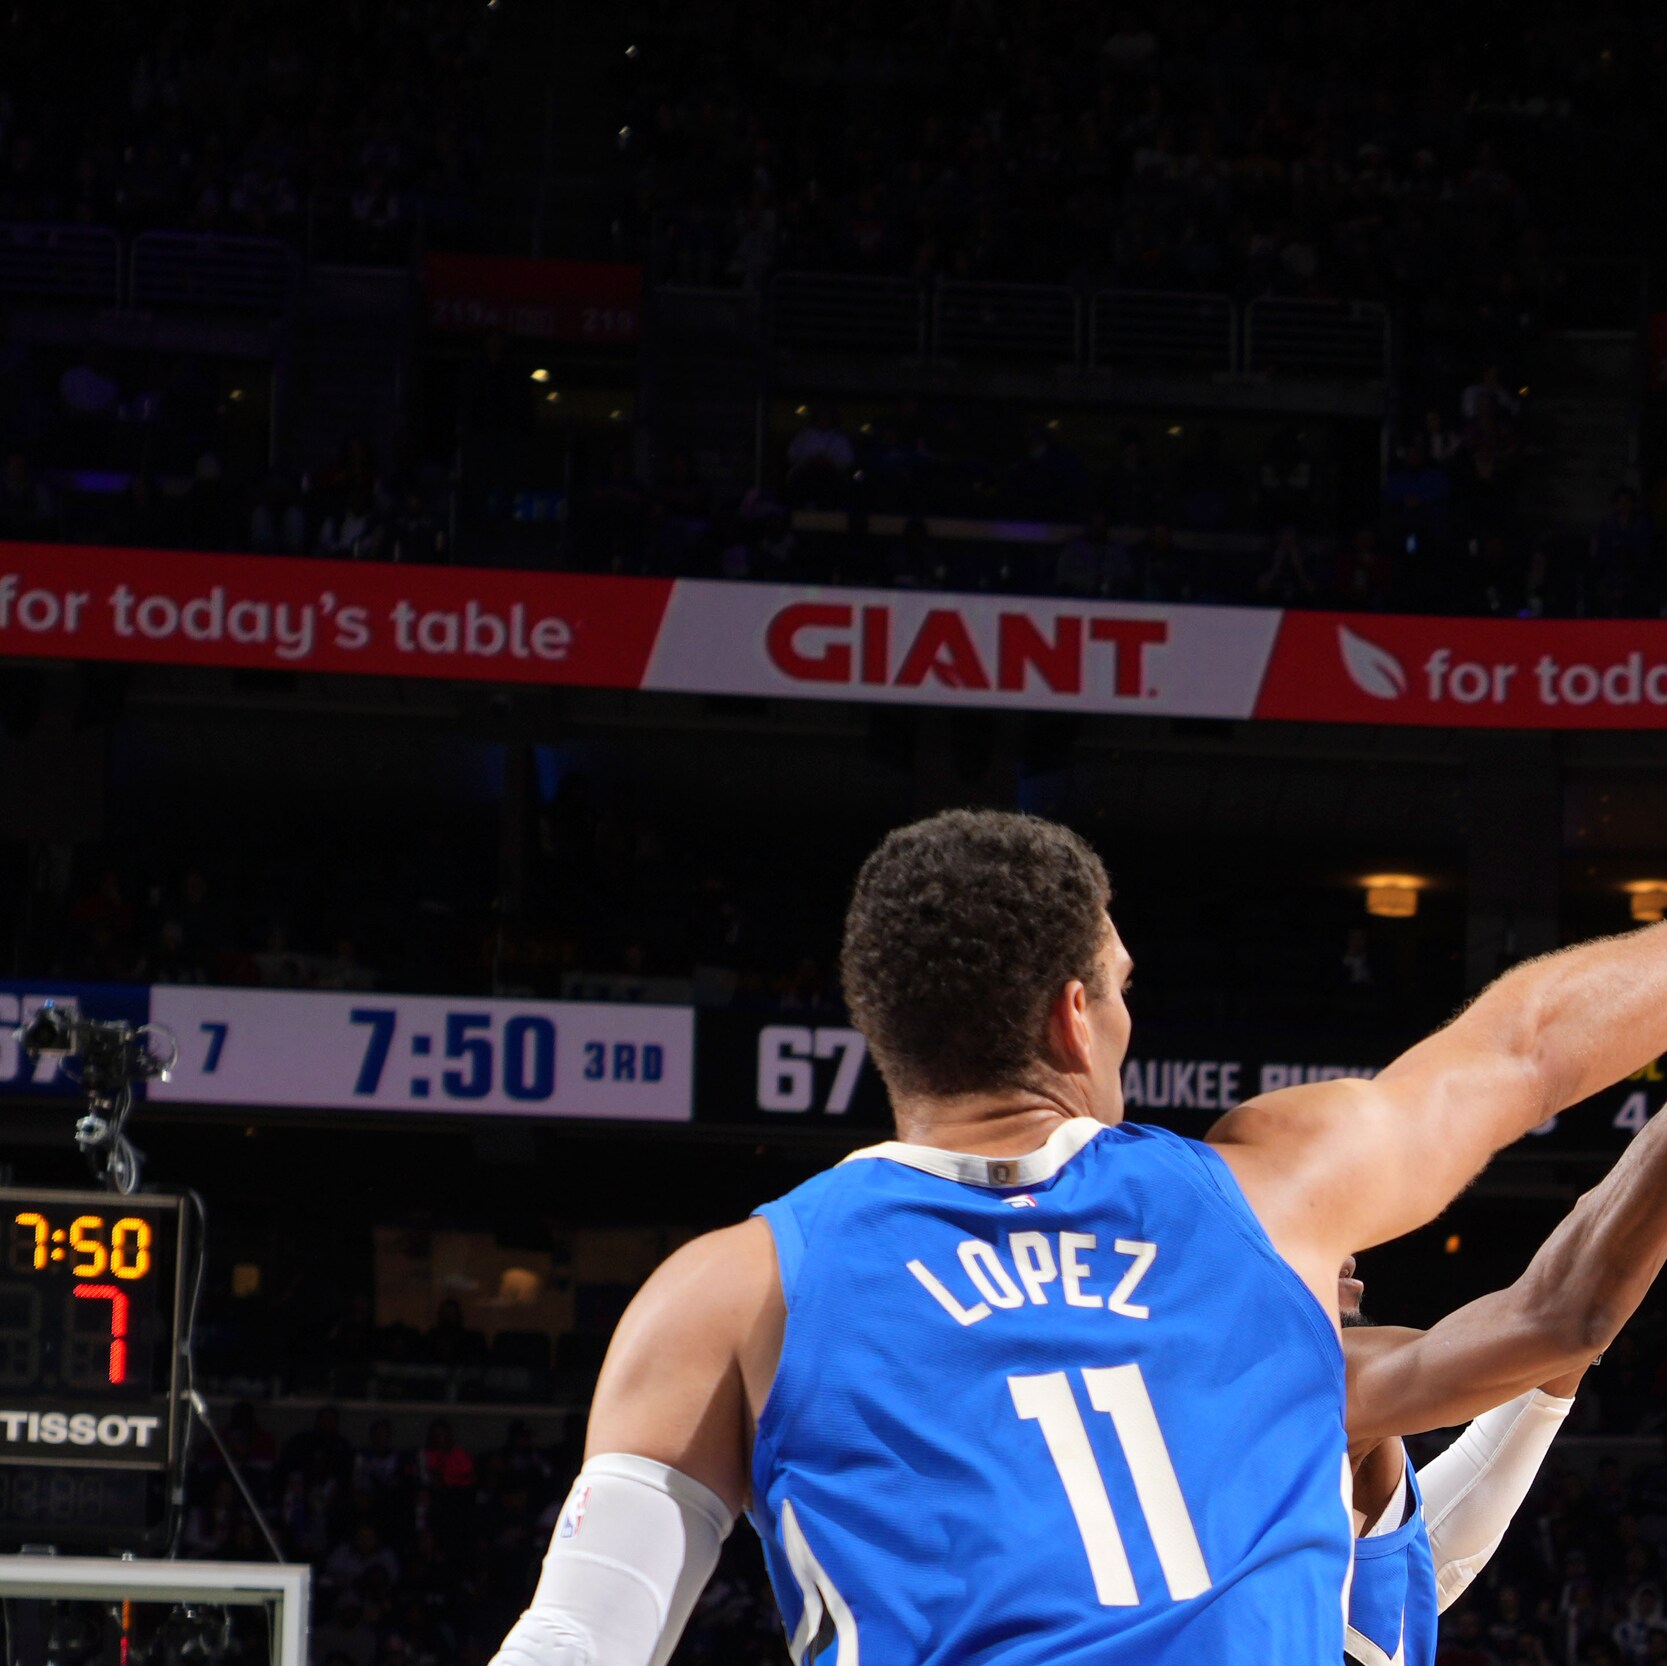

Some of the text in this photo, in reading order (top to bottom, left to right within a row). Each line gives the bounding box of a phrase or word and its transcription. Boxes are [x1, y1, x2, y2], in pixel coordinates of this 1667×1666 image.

[0, 573, 573, 661] for today's table
[766, 602, 1168, 697] GIANT
[1424, 647, 1516, 705] for
[201, 1023, 229, 1073] 7
[349, 1009, 665, 1100] 7:50 3RD
[756, 1024, 867, 1115] 67
[15, 1211, 153, 1281] 7:50
[906, 1231, 1157, 1327] LOPEZ
[72, 1282, 131, 1386] 7
[0, 1411, 159, 1449] TISSOT
[1007, 1362, 1213, 1607] 11
